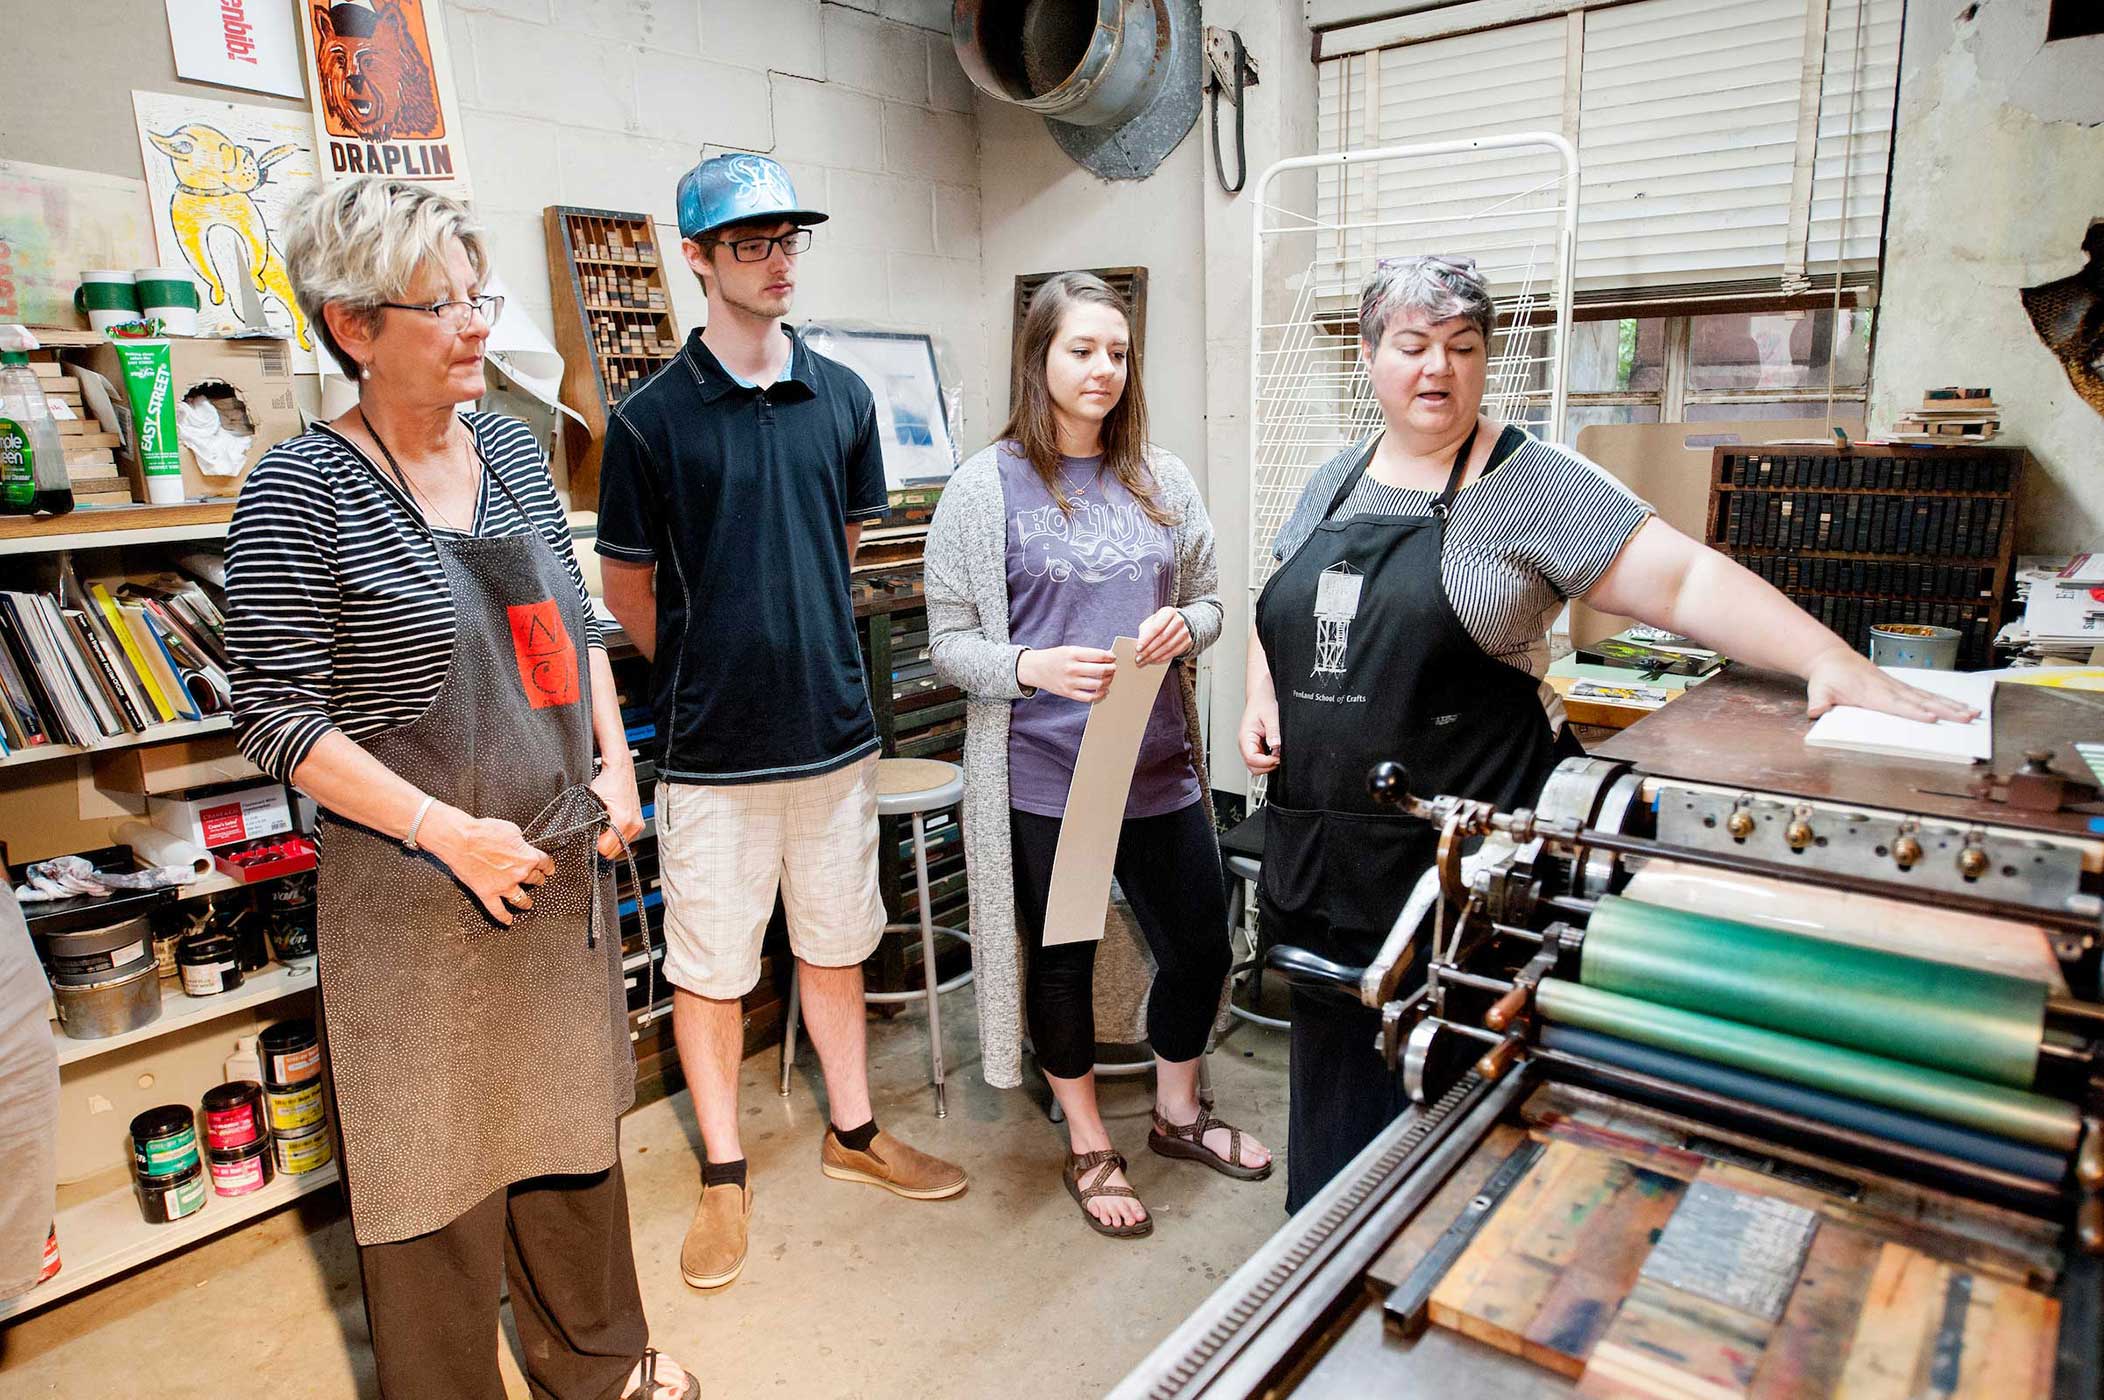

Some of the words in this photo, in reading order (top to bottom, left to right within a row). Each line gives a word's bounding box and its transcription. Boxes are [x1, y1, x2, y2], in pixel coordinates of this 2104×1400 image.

[330, 141, 453, 175] DRAPLIN
[147, 364, 170, 415] STREET
[141, 415, 156, 452] EASY
[1315, 693, 1335, 703] School
[1336, 695, 1344, 704] of
[1346, 694, 1366, 703] Crafts
